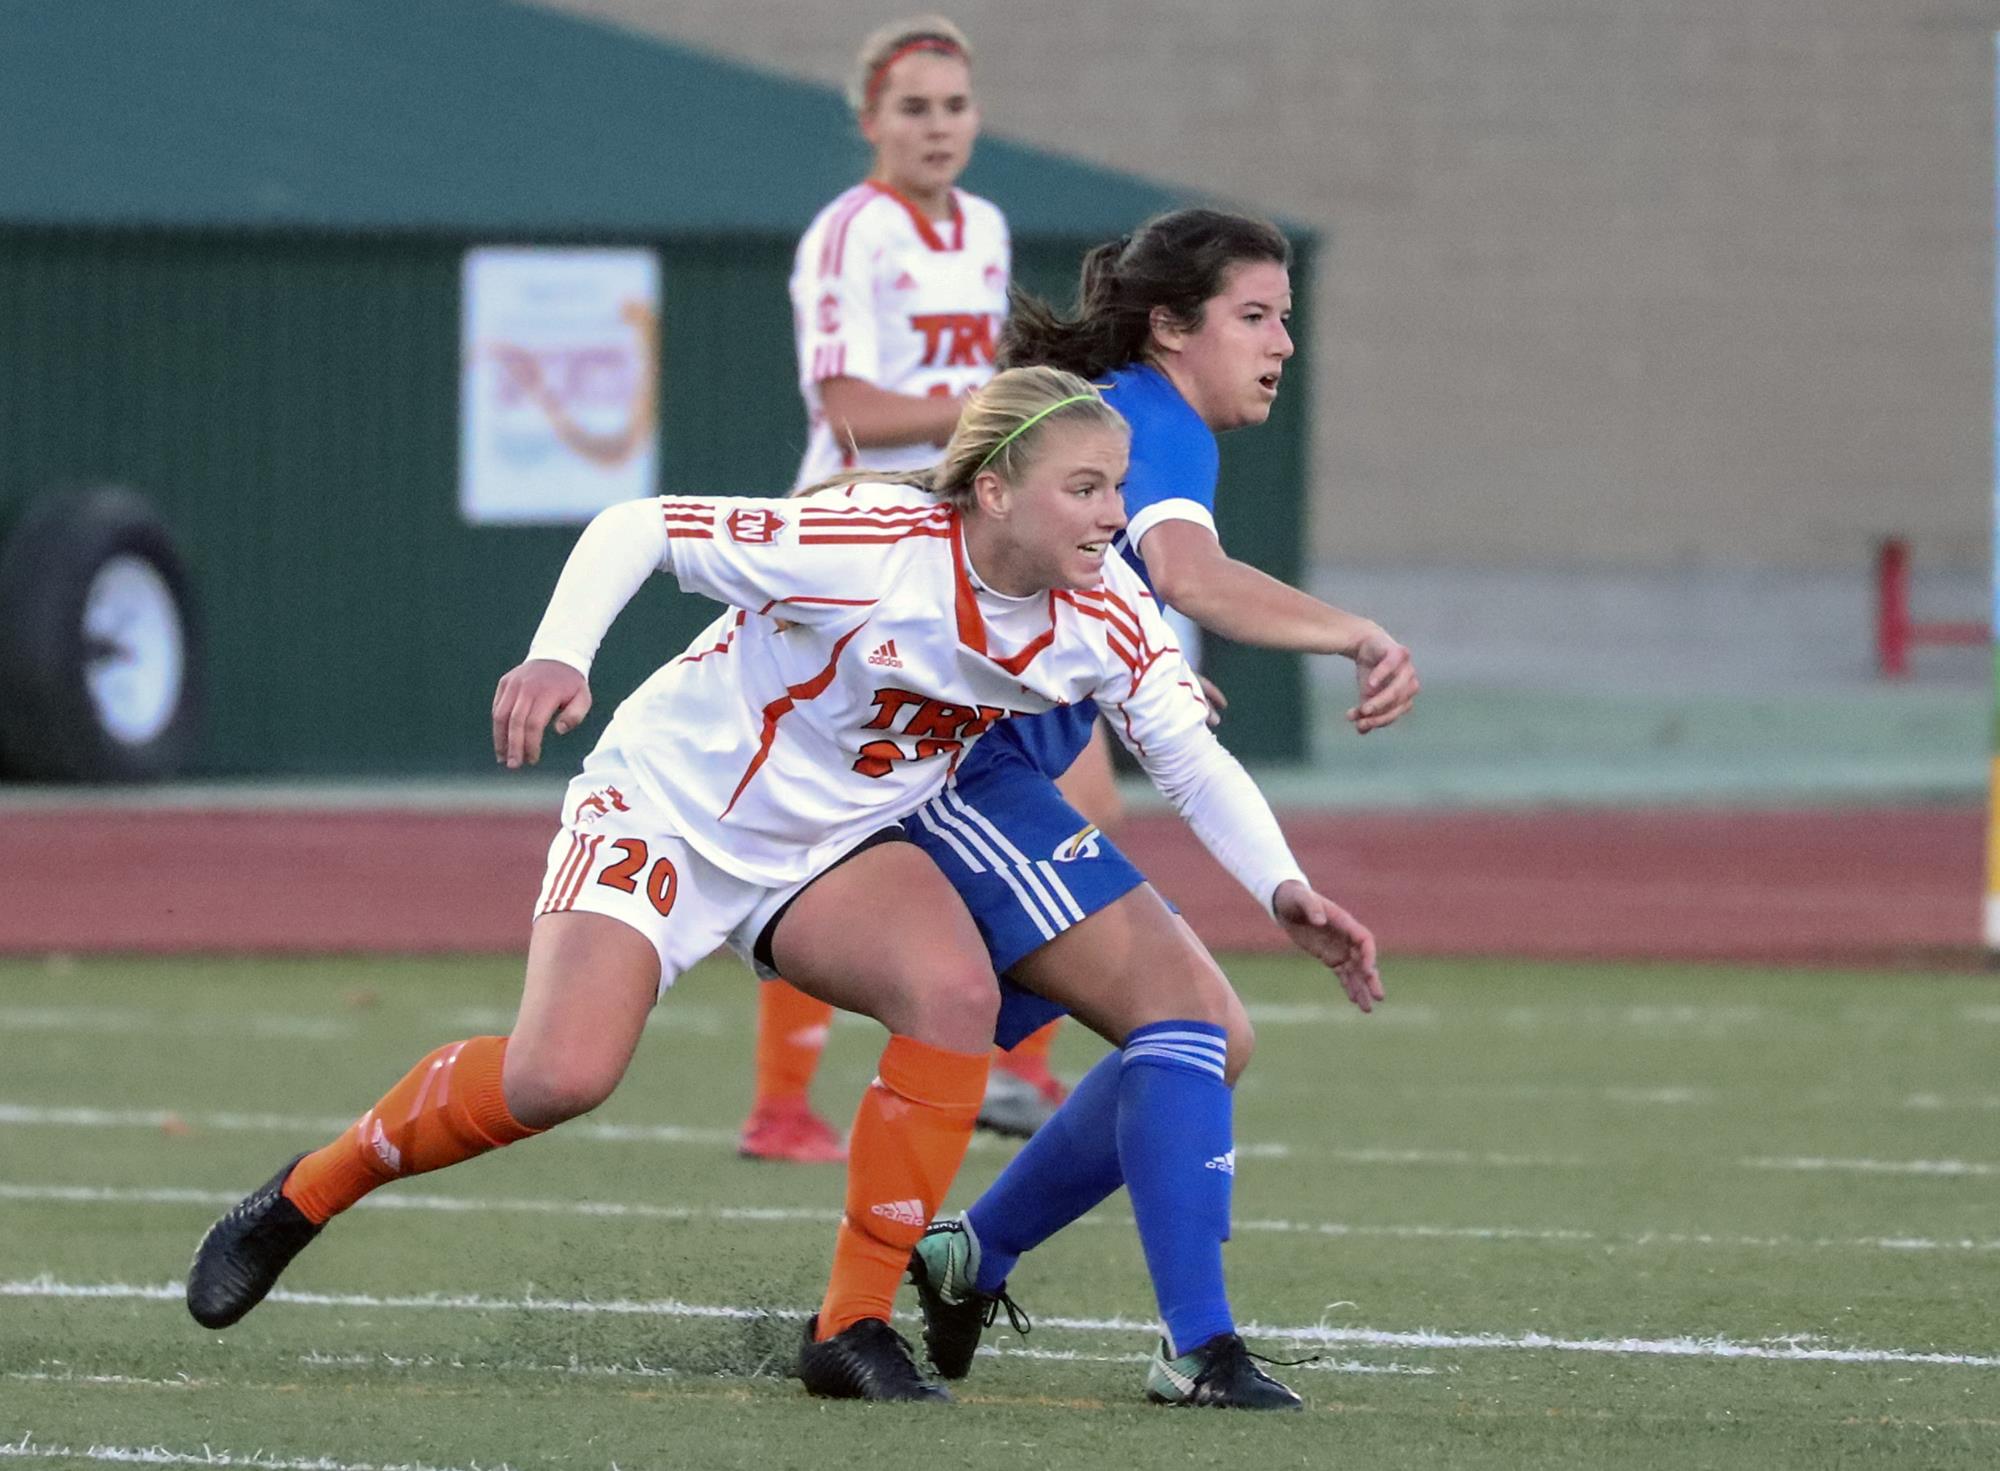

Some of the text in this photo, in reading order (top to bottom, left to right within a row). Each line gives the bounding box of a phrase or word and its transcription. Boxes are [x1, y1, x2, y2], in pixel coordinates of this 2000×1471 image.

[868, 655, 904, 669] adidas
[597, 837, 678, 918] 20
[870, 1204, 926, 1227] adida
